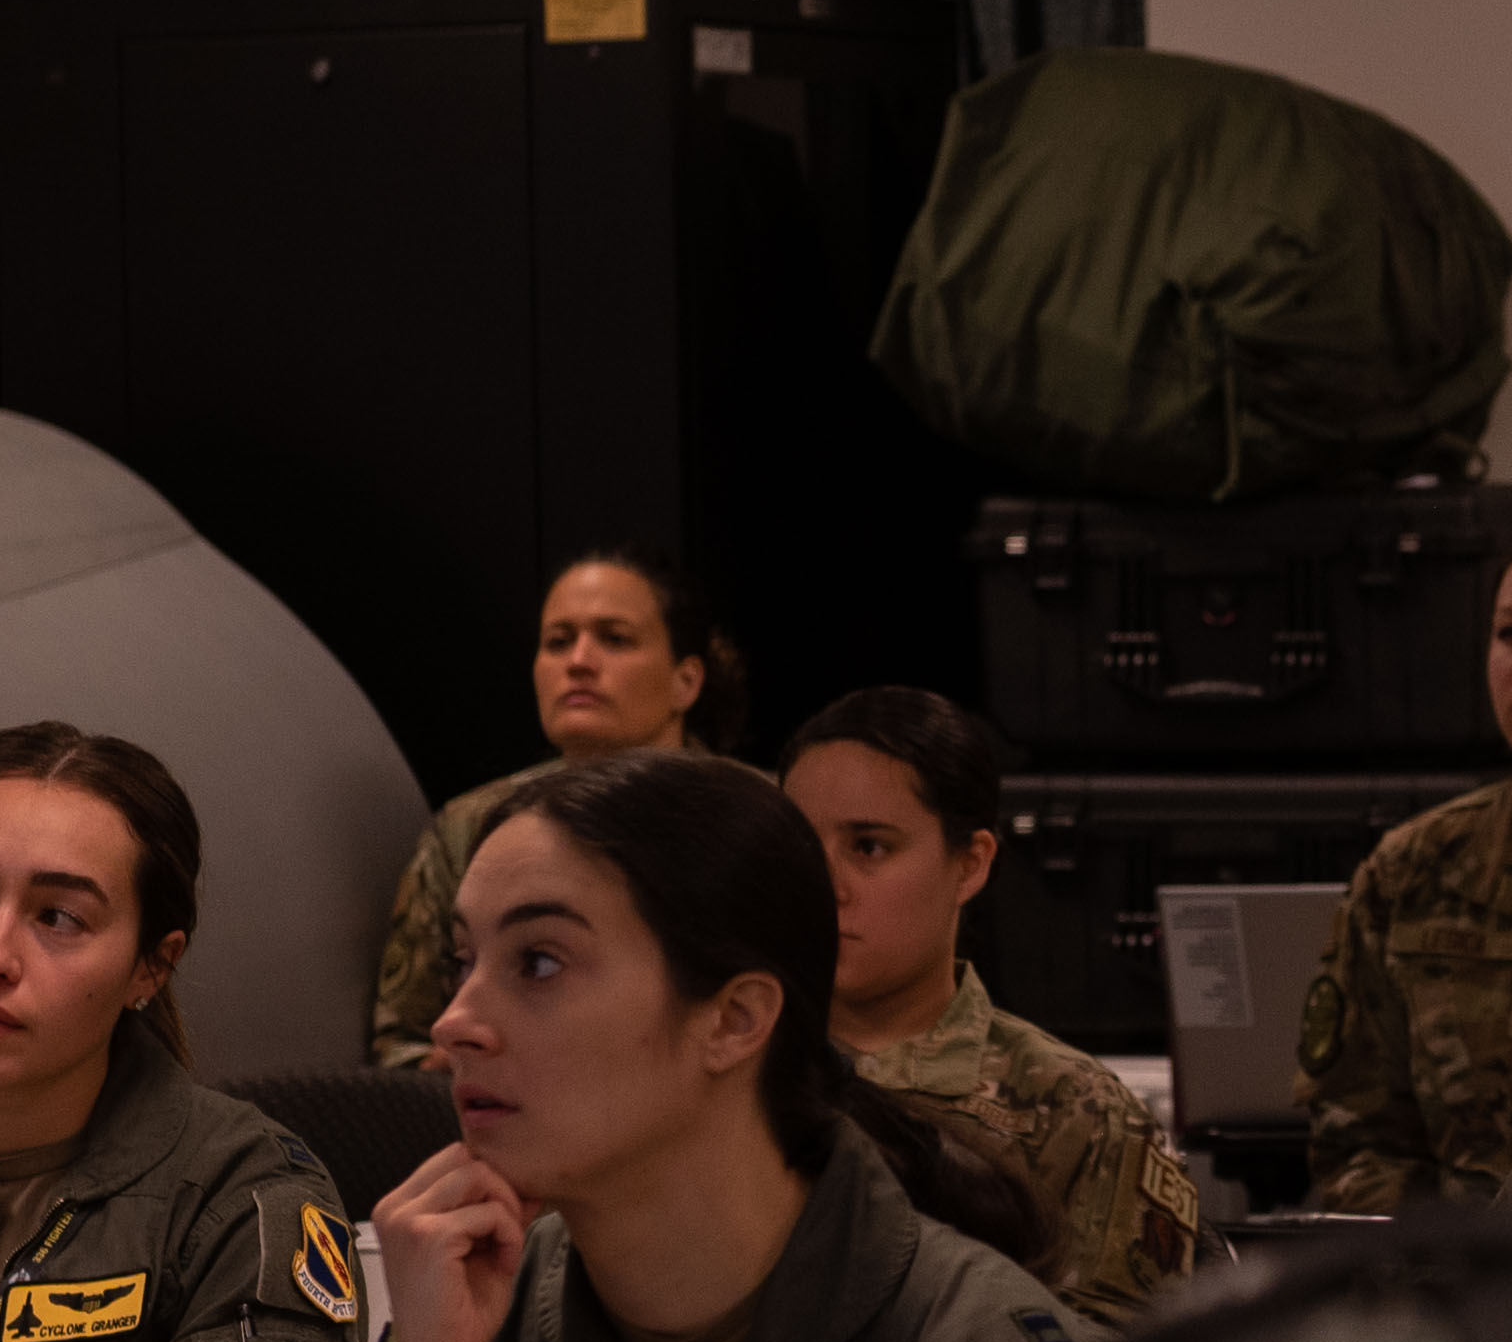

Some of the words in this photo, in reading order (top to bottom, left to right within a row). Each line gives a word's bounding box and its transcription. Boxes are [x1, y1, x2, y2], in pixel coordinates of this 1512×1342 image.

[298, 1271, 331, 1309] FOURTH
[39, 1322, 88, 1338] CYCLONE
[91, 1315, 138, 1333] GRANGER
